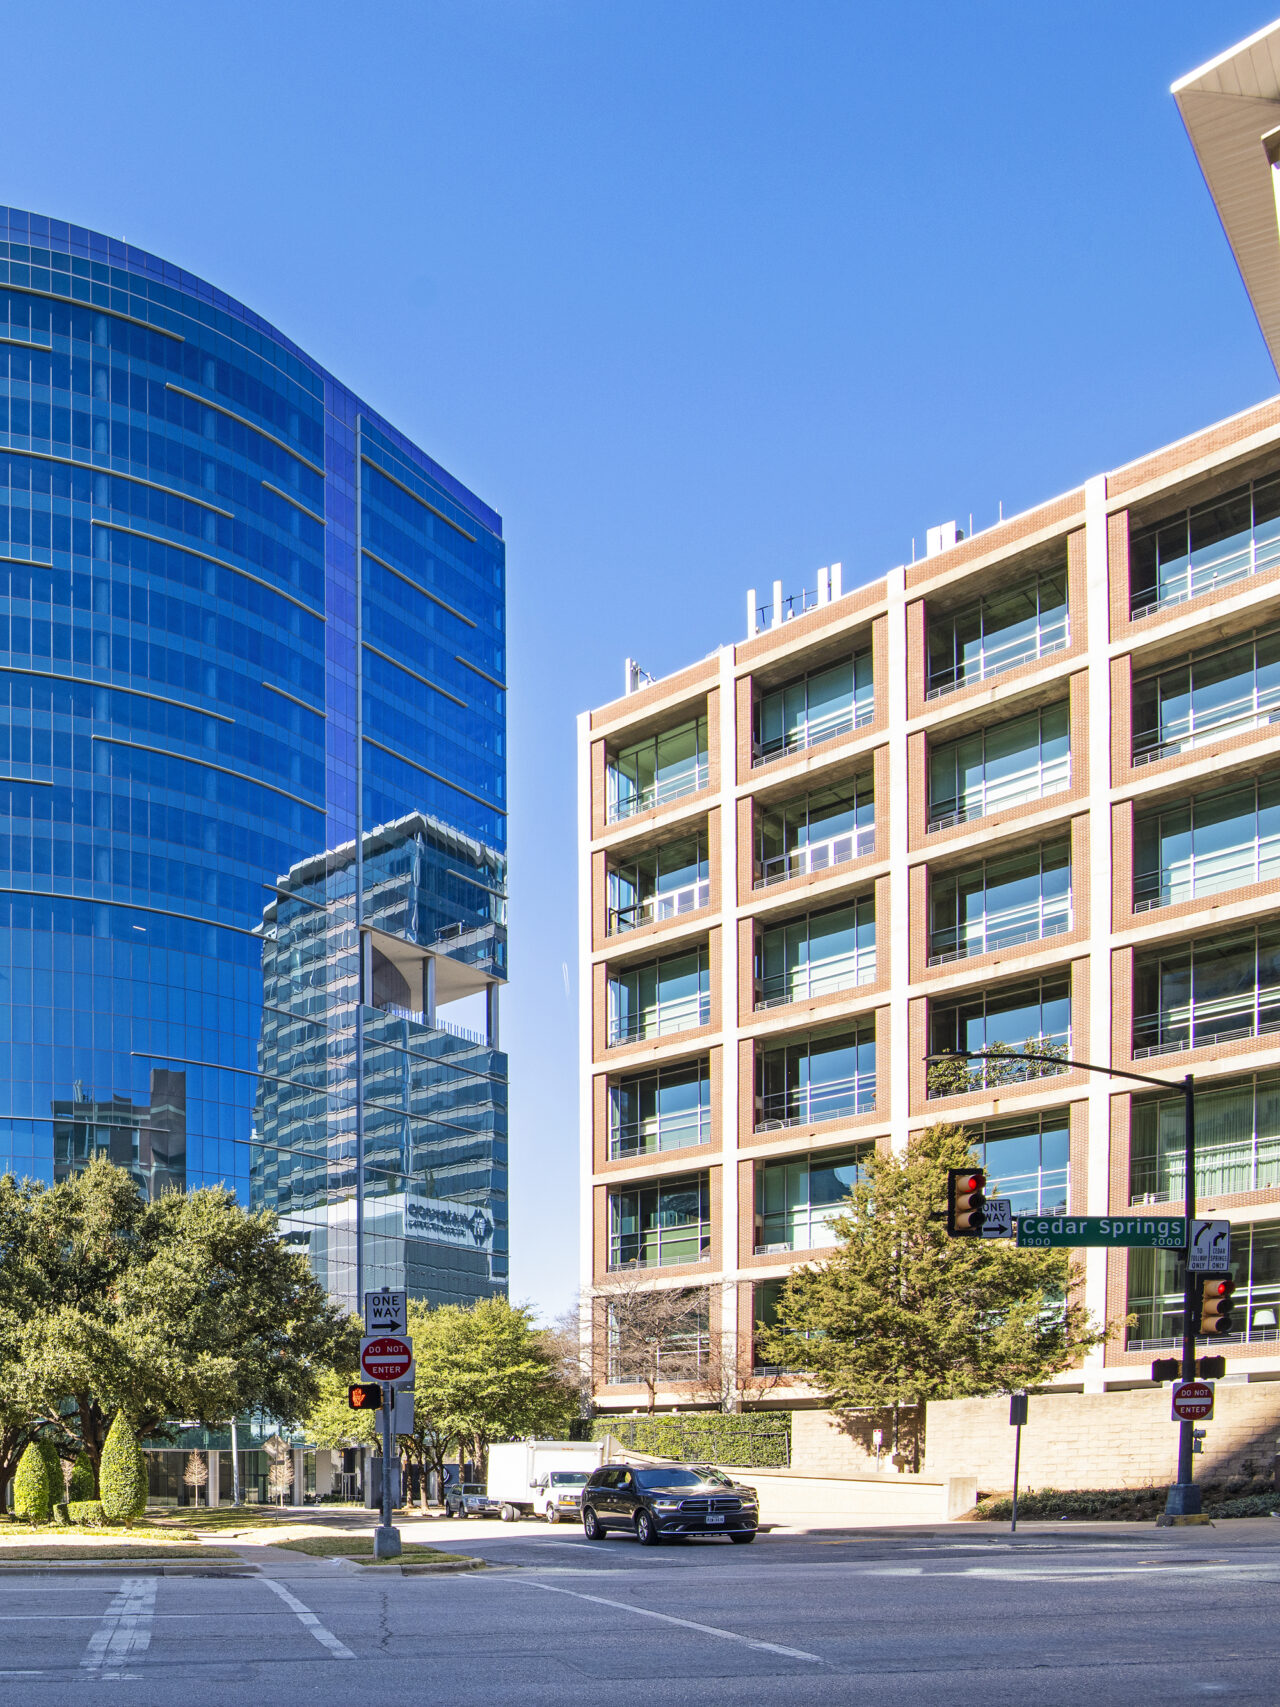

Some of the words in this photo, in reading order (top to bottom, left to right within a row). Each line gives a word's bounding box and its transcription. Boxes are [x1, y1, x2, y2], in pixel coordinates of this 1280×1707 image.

[982, 1203, 1005, 1211] ONE
[1022, 1219, 1088, 1234] Cedar
[1099, 1218, 1181, 1238] Springs
[1022, 1237, 1051, 1246] 1900
[1151, 1237, 1181, 1246] 2000
[372, 1295, 400, 1306] ONE
[373, 1307, 401, 1318] WAY
[386, 1345, 404, 1353] NOT
[372, 1366, 401, 1374] ENTER
